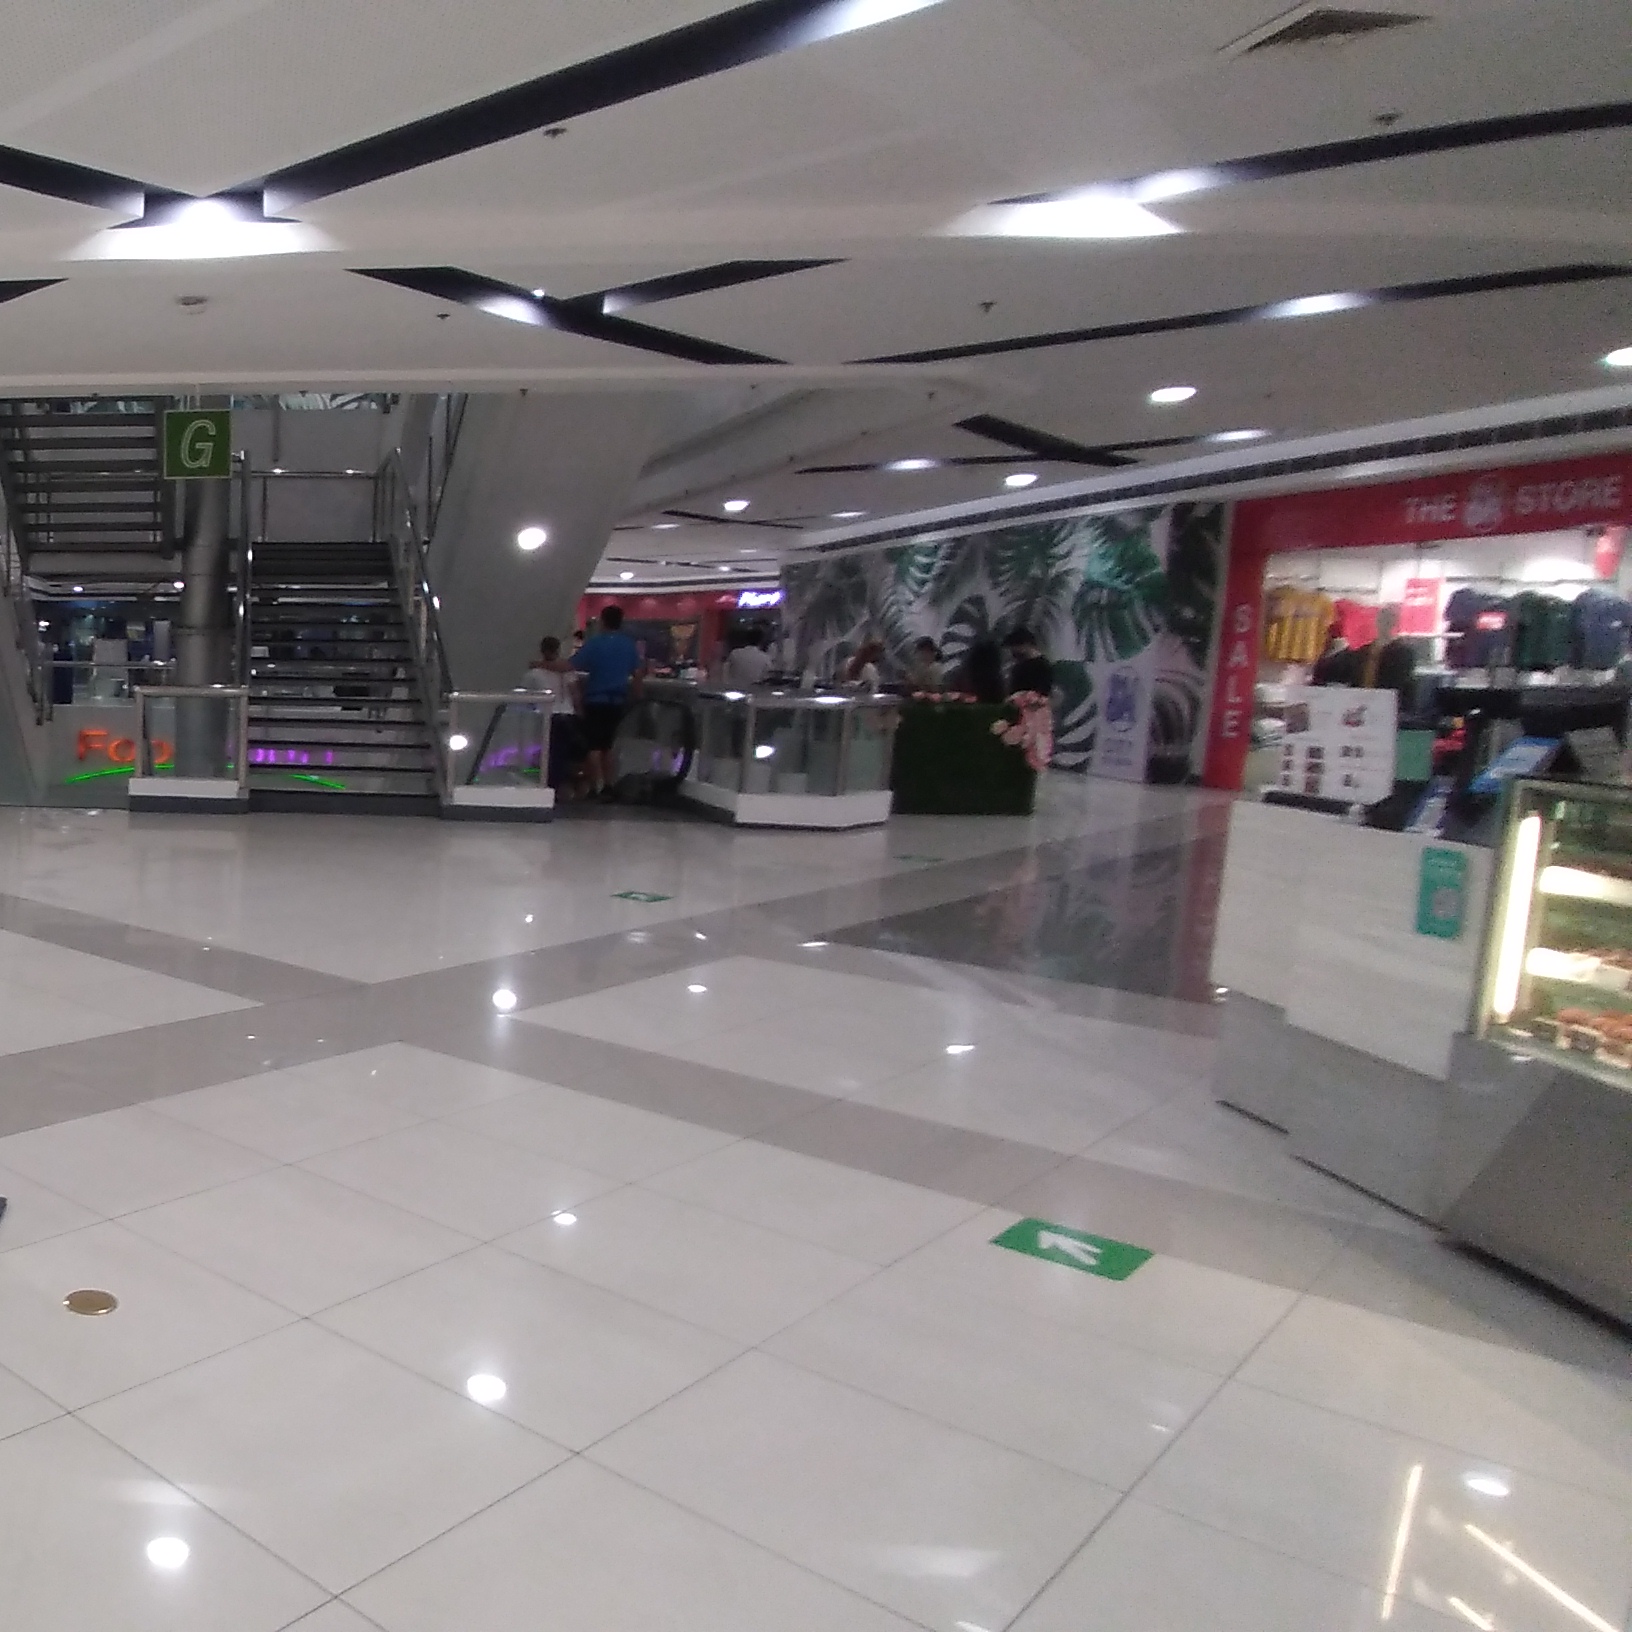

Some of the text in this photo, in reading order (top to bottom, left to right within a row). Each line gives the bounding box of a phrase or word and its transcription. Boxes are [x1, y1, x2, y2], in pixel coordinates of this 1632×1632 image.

[180, 419, 216, 469] G
[1405, 493, 1458, 524] THE
[1516, 475, 1622, 516] STORE
